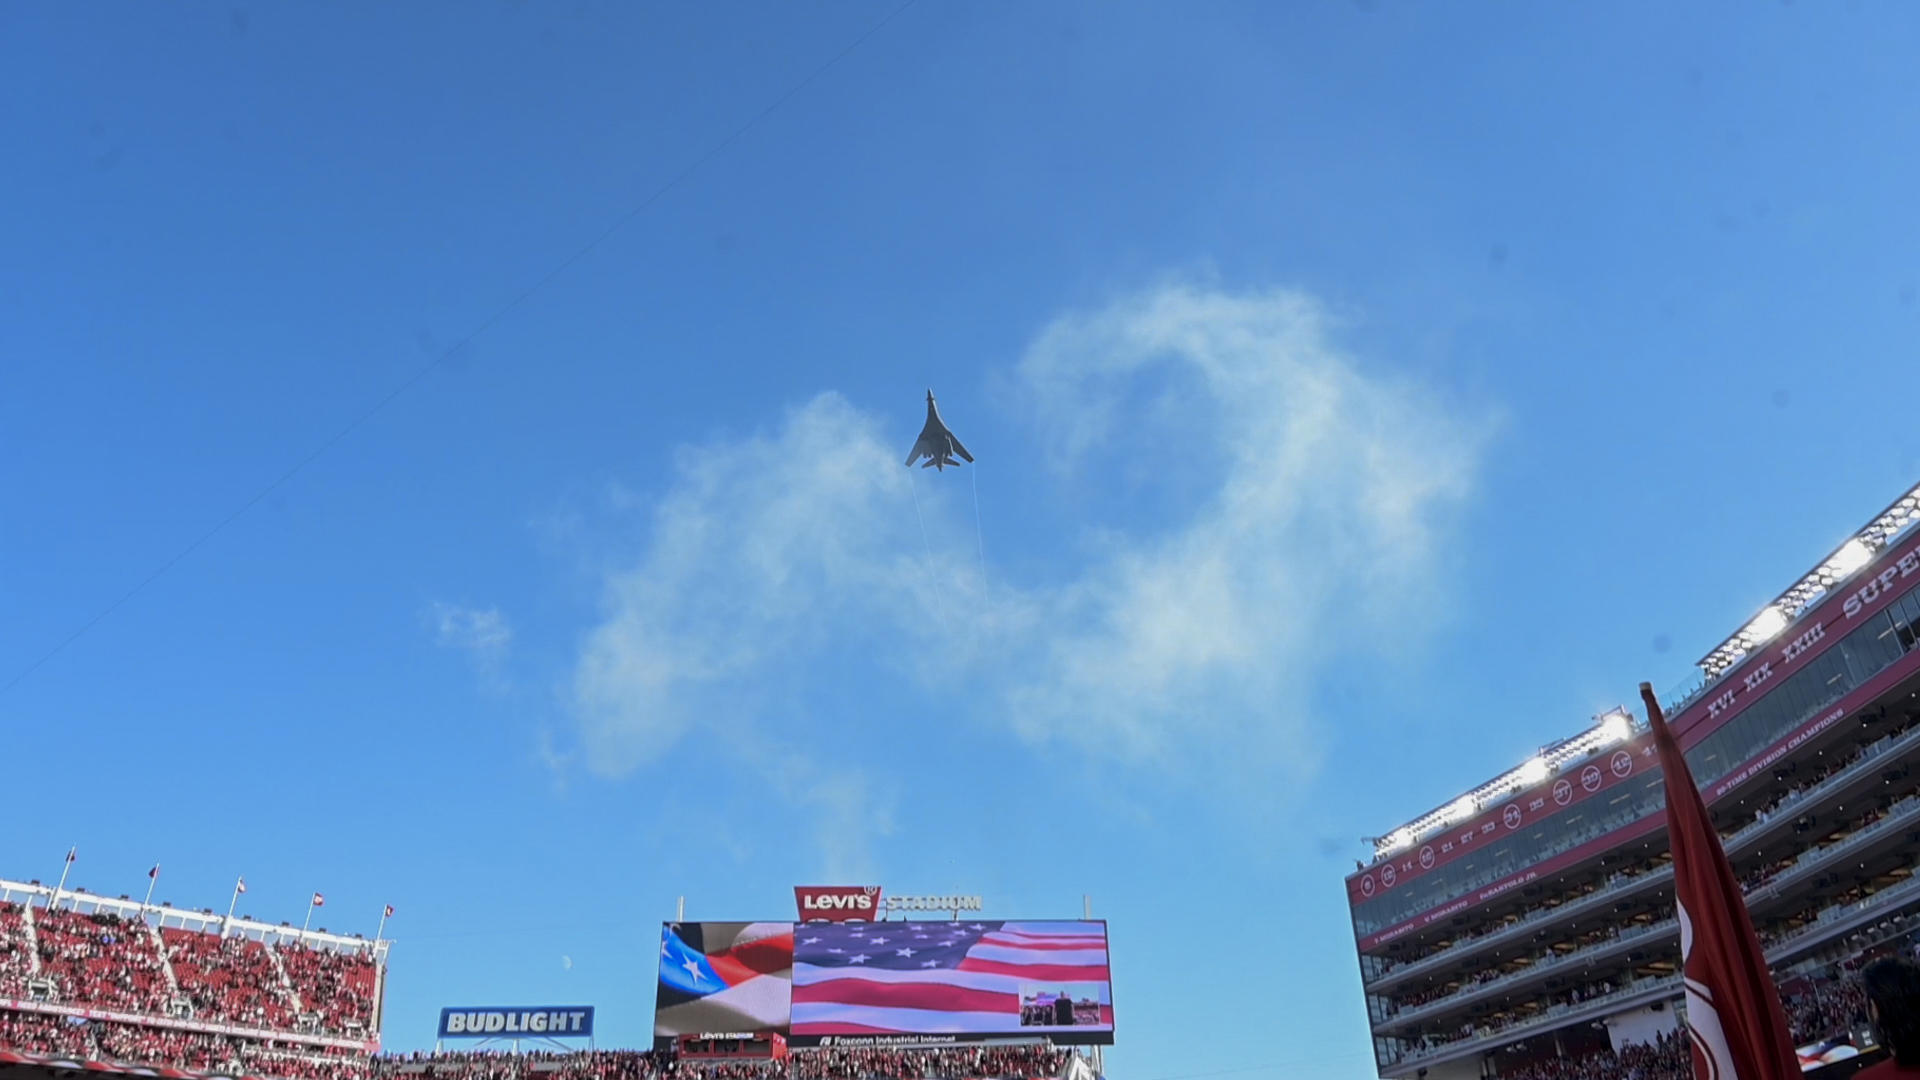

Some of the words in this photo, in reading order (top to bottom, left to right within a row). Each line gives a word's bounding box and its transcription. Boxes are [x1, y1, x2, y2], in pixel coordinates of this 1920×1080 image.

[1843, 545, 1920, 619] SUPE
[1748, 745, 1787, 776] DIVISION
[1788, 708, 1844, 749] CHAMPIONS
[887, 895, 982, 911] STADIUM
[834, 1035, 874, 1046] Foxconn
[875, 1034, 919, 1045] Industrial
[920, 1034, 956, 1043] Internet
